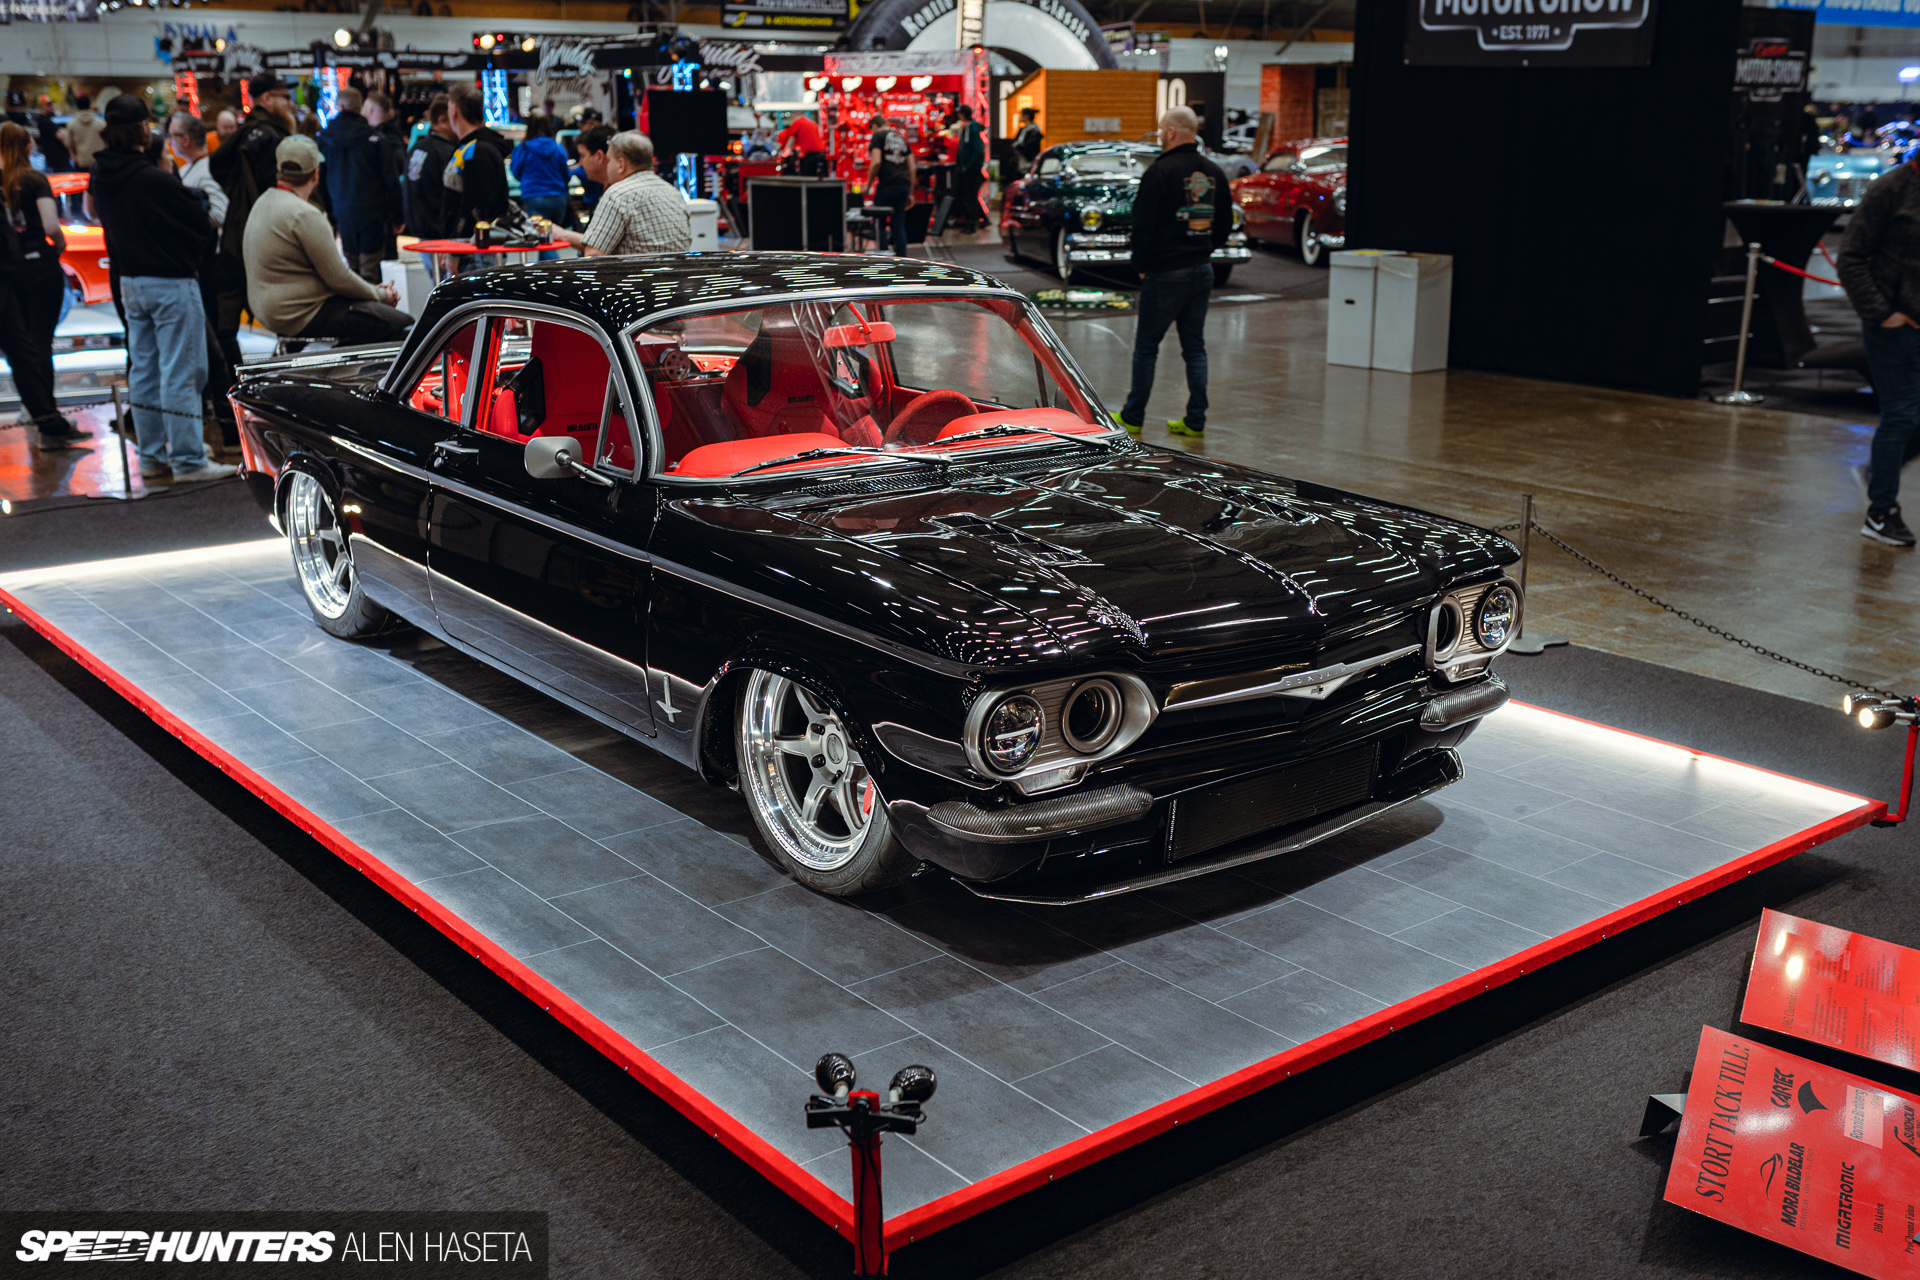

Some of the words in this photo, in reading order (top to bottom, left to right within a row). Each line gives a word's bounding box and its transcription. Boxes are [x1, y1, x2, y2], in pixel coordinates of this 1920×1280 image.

[1499, 25, 1523, 40] EST.
[1526, 24, 1550, 40] 1971
[1718, 1044, 1750, 1086] TILL:
[1770, 1066, 1795, 1109] CARTEC
[1851, 1089, 1868, 1118] Broberg
[1708, 1083, 1743, 1135] TACK
[1849, 1115, 1863, 1141] Ronnie
[1695, 1133, 1734, 1204] STORT
[1785, 1141, 1805, 1193] BILDELAR
[1780, 1190, 1800, 1228] MORA
[1835, 1161, 1855, 1250] MIGATRONIC
